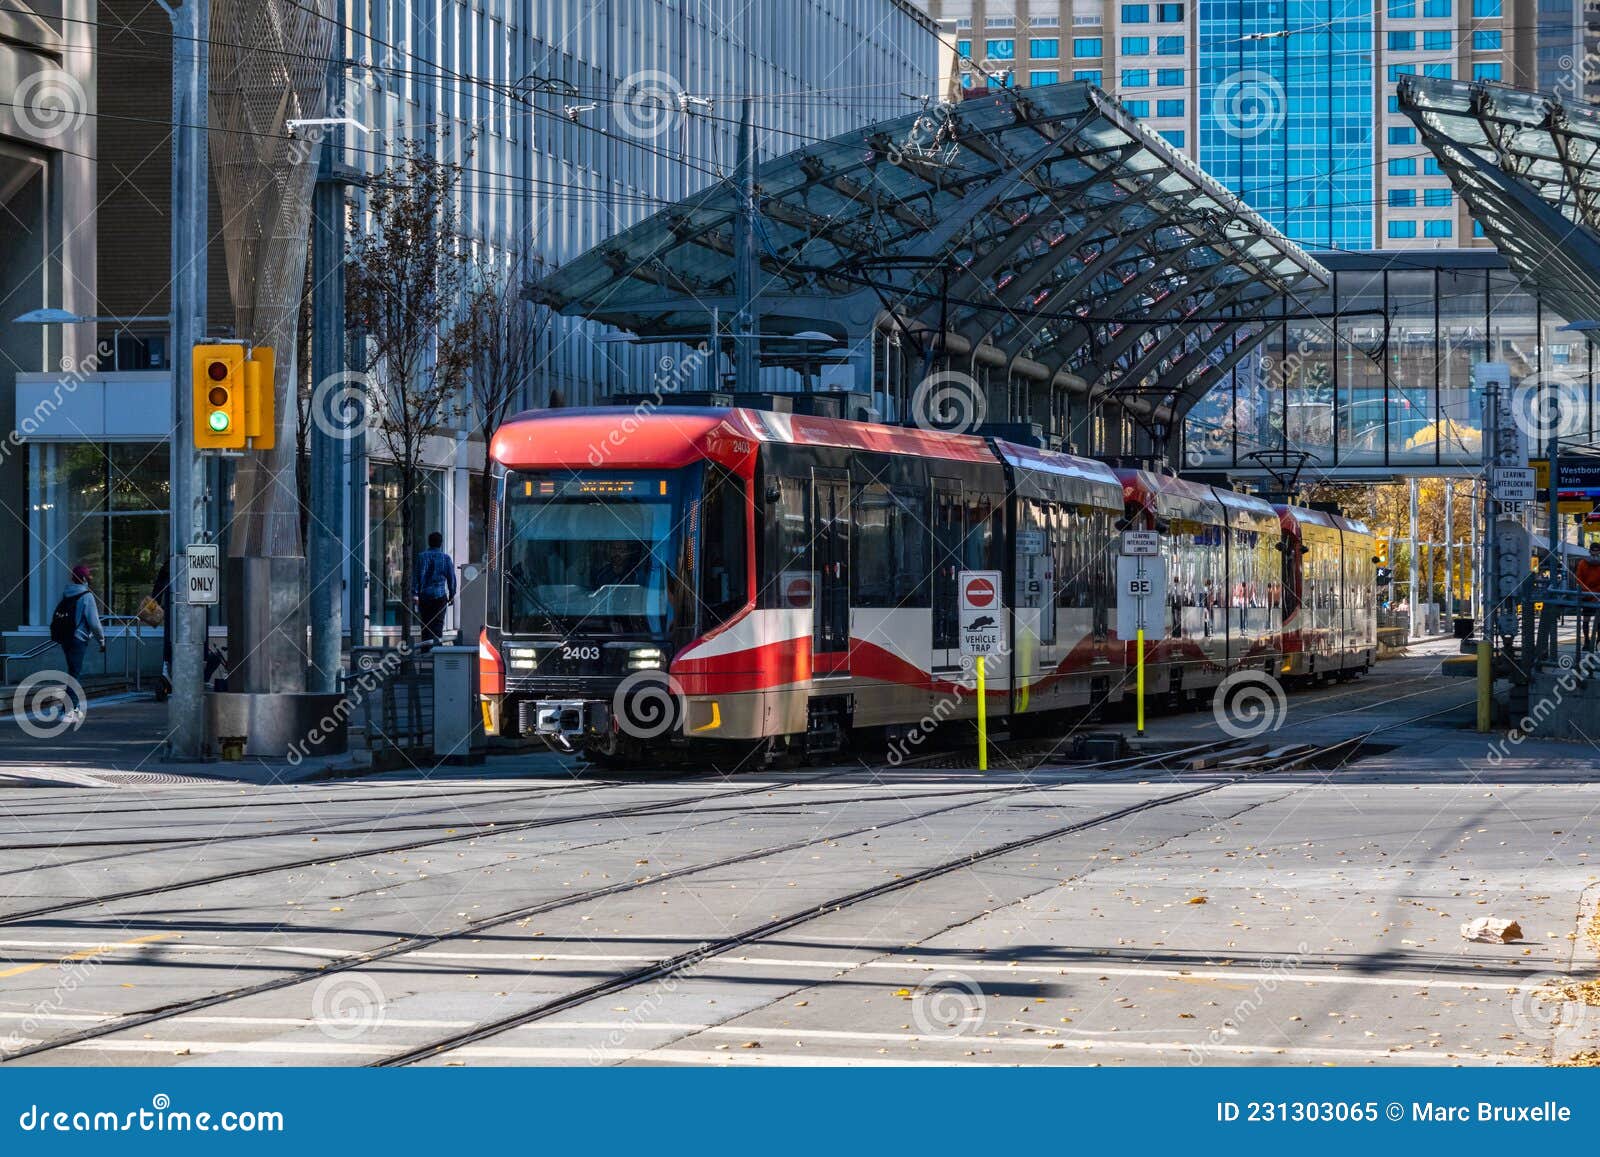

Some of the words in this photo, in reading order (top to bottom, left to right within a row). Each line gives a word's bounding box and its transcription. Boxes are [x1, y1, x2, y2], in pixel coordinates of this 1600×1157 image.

[733, 441, 750, 453] 2403
[1560, 476, 1581, 484] Train
[1504, 501, 1523, 512] BE
[189, 555, 215, 569] TRANSIT
[190, 577, 214, 591] ONLY
[1130, 581, 1149, 592] BE
[966, 635, 996, 644] VEHICLE
[562, 646, 600, 660] 2403
[971, 644, 990, 652] TRAP
